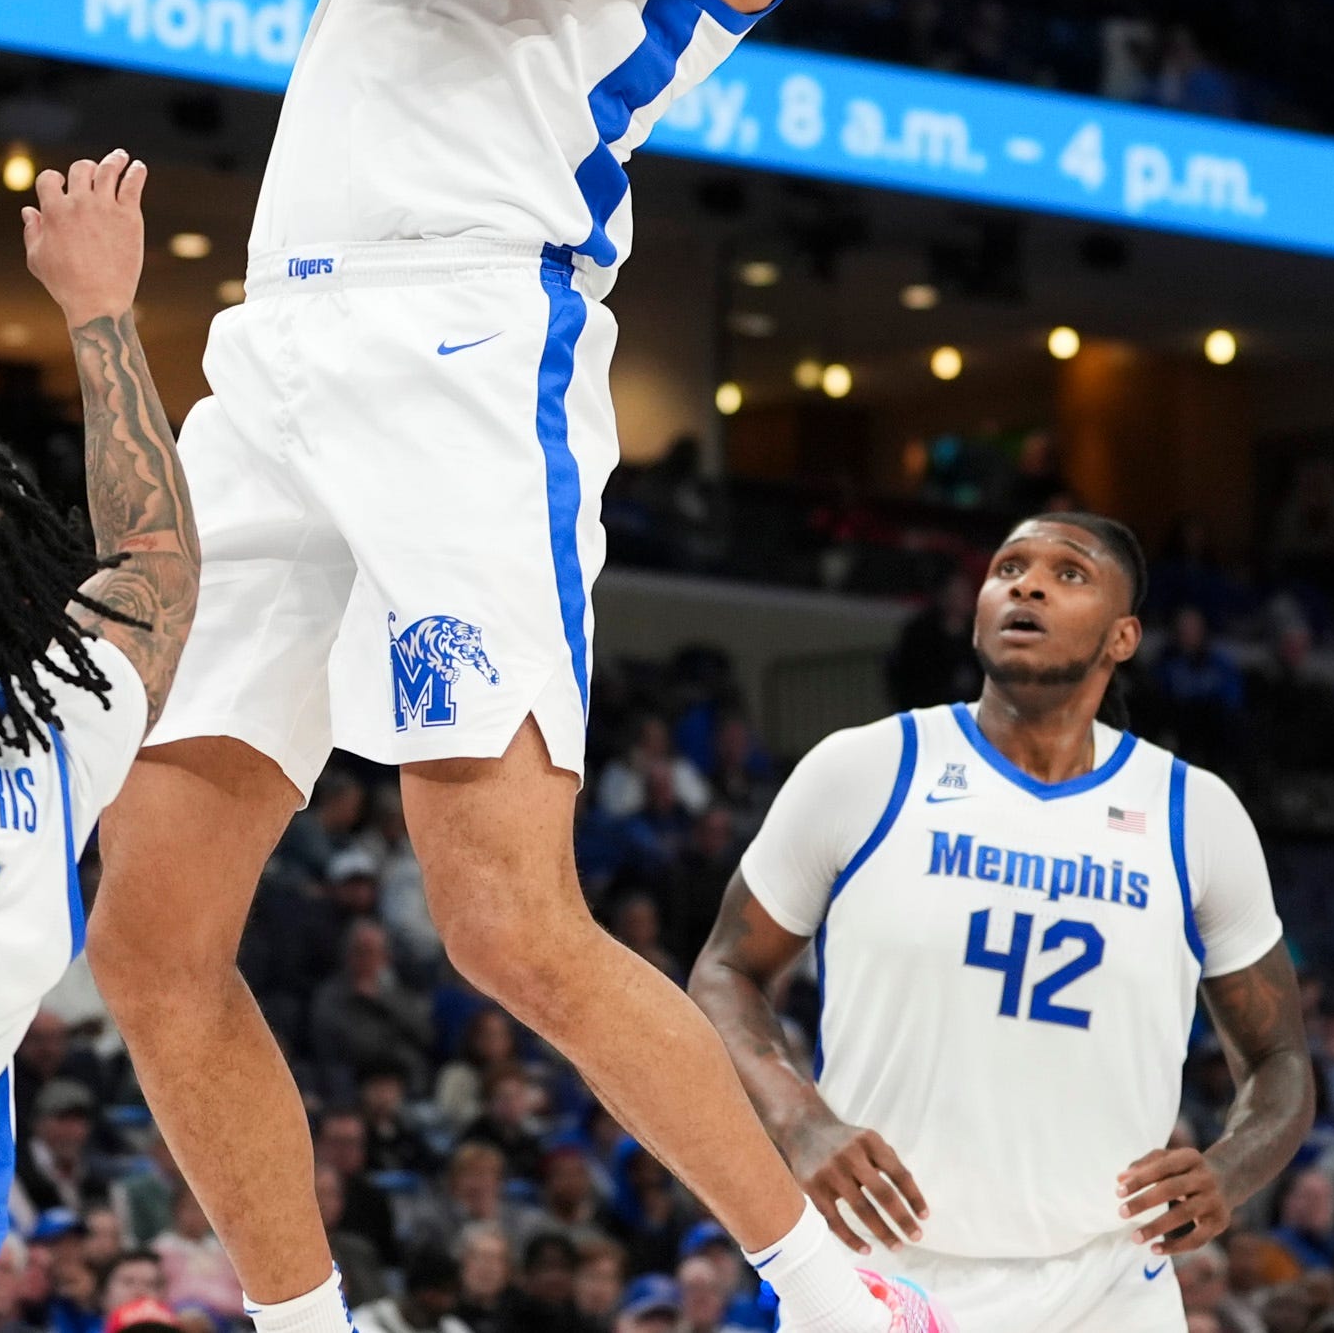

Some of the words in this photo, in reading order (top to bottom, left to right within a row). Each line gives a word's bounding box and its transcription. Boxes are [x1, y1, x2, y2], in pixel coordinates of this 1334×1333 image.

[775, 73, 825, 150] 8
[841, 98, 987, 174] a.m.
[1060, 121, 1105, 191] 4
[1123, 142, 1266, 214] p.m.
[288, 258, 335, 279] Tigers
[926, 830, 1150, 911] Memphis
[963, 907, 1105, 1031] 42
